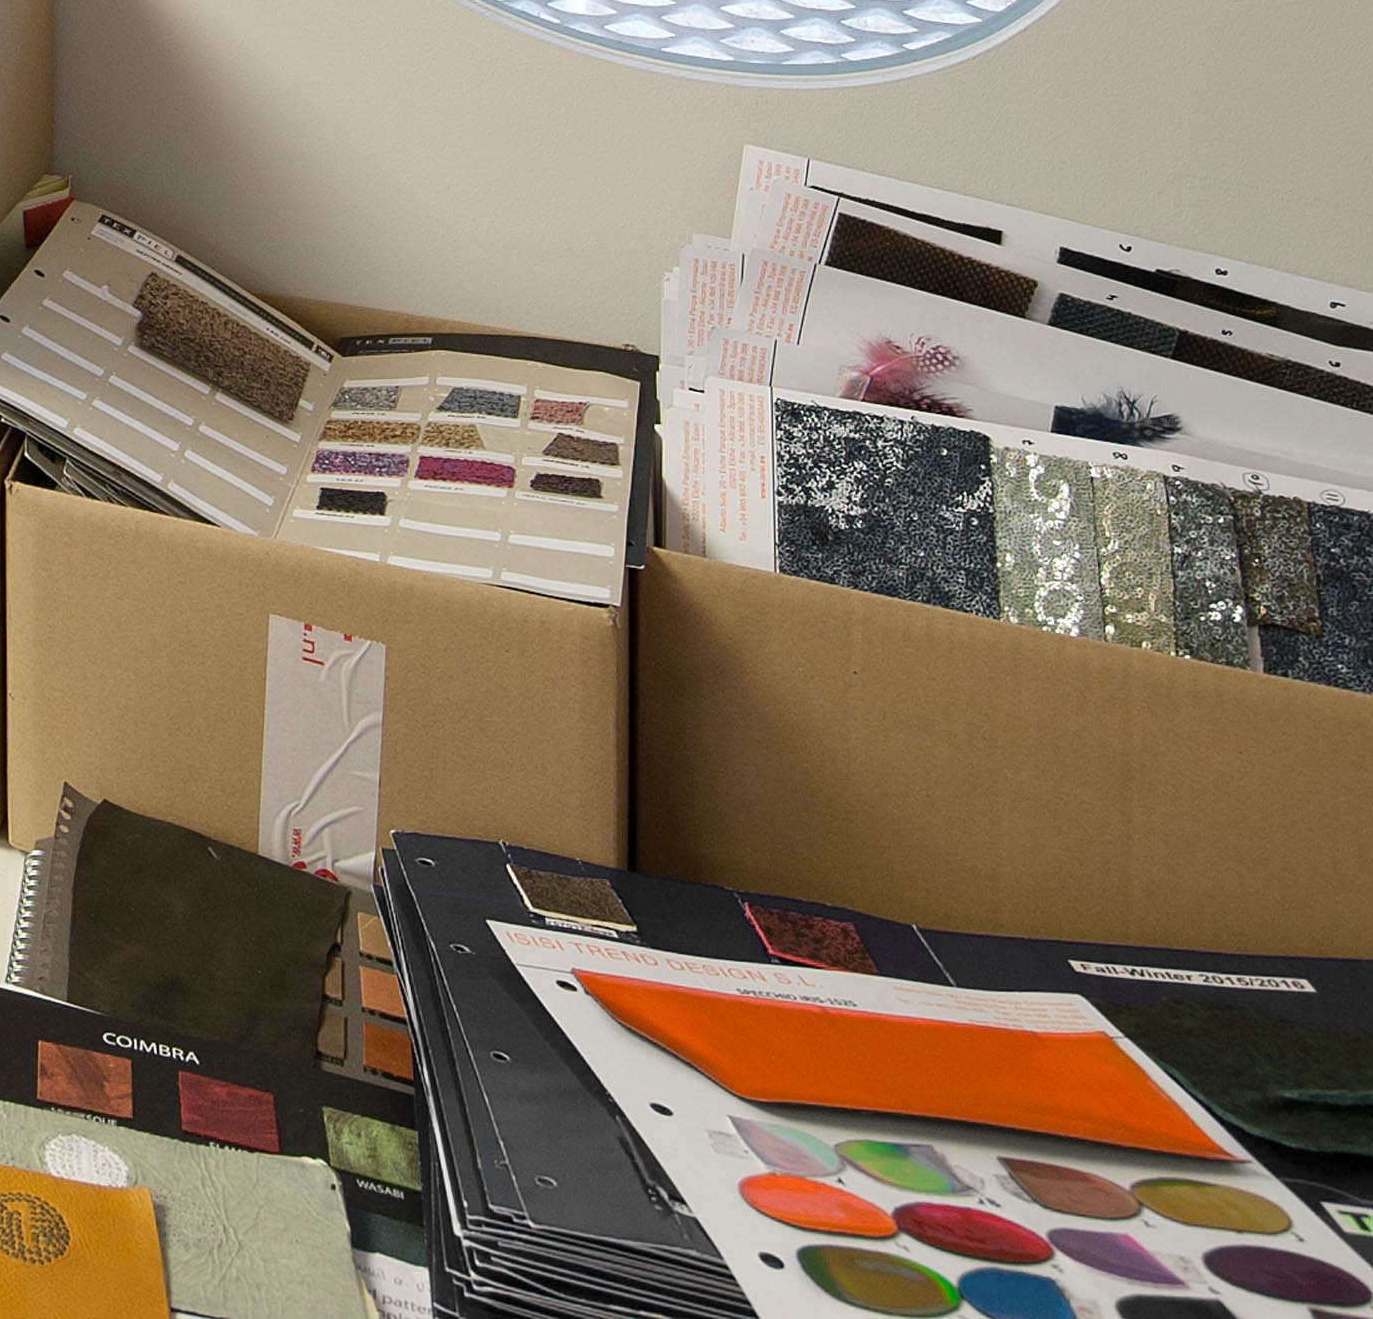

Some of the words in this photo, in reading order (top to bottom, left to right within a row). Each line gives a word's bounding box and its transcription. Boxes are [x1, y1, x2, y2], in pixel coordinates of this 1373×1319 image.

[569, 941, 660, 968] TREND
[665, 957, 768, 985] DESIGN
[1080, 963, 1193, 983] Fall-Winter
[1202, 973, 1305, 991] 2015/2016
[102, 1031, 201, 1066] COIMBRA
[356, 1179, 405, 1200] WASABI
